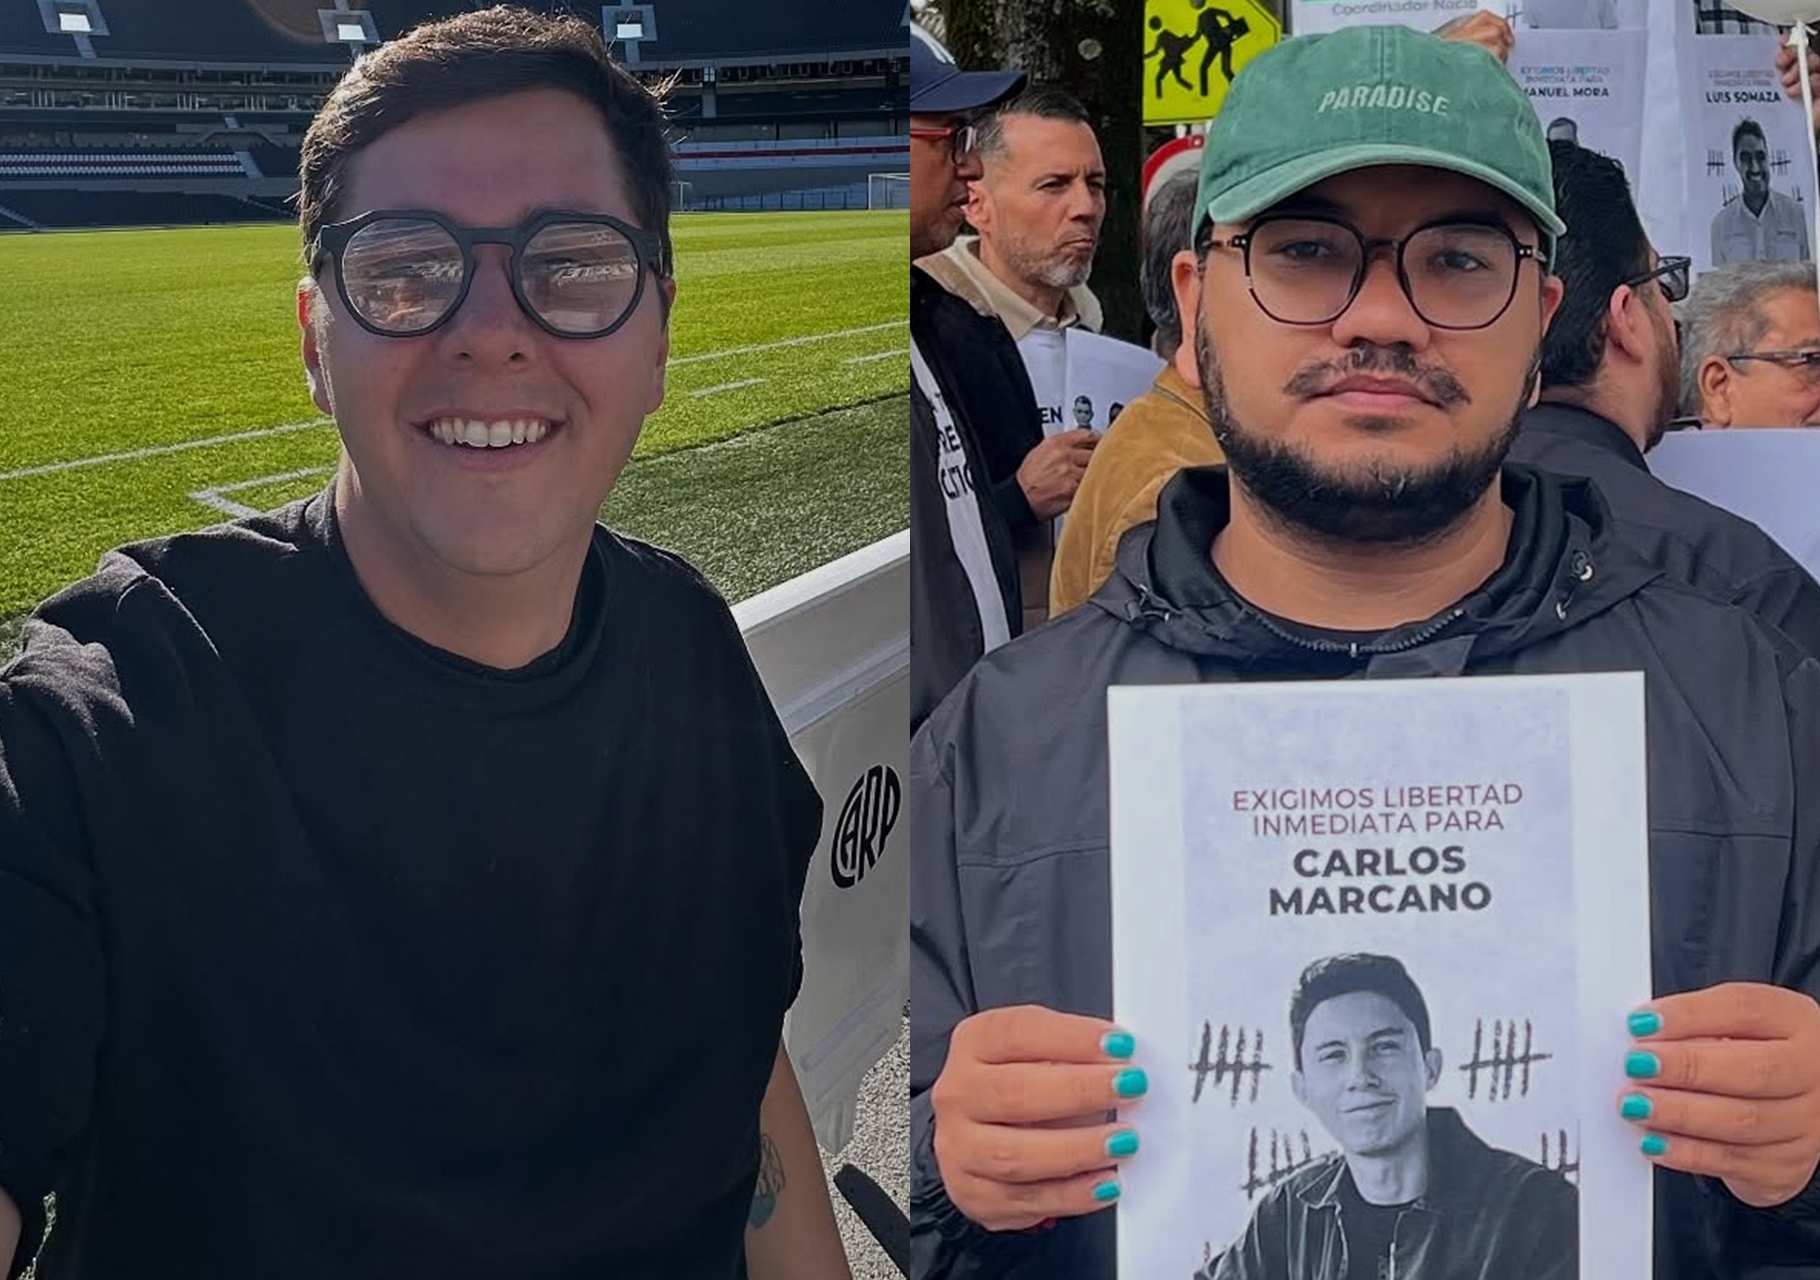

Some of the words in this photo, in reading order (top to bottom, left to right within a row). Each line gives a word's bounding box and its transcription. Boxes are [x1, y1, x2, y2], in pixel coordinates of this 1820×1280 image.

[1317, 85, 1449, 116] PARADISE
[1573, 87, 1610, 98] MORA
[1706, 91, 1731, 103] LUIS
[1734, 91, 1781, 103] SOMAZA
[1233, 788, 1374, 811] EXIGIMOS
[1384, 784, 1523, 808] LIBERTAD
[1254, 812, 1416, 837] INMEDIATA
[1425, 809, 1504, 833] PARA
[1293, 845, 1467, 878] CARLOS
[1269, 881, 1492, 916] MARCANO
